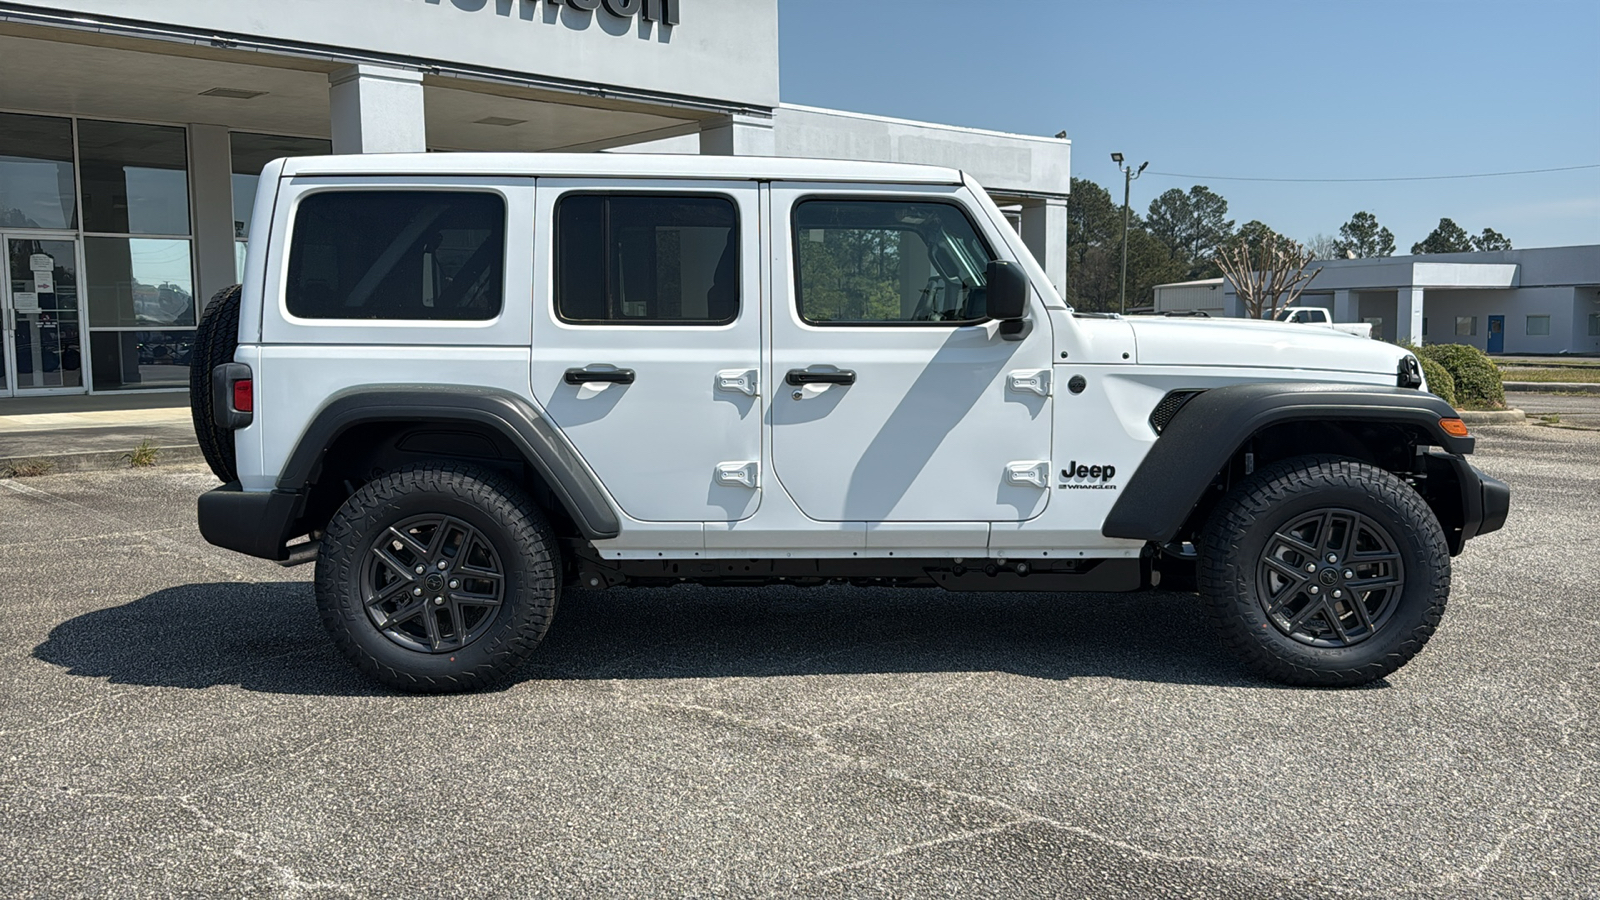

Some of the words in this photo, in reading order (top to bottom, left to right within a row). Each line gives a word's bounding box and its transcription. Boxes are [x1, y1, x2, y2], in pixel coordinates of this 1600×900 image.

[1061, 460, 1116, 482] Jeep
[338, 530, 363, 621] ROADIAN
[483, 570, 524, 654] NEXEN
